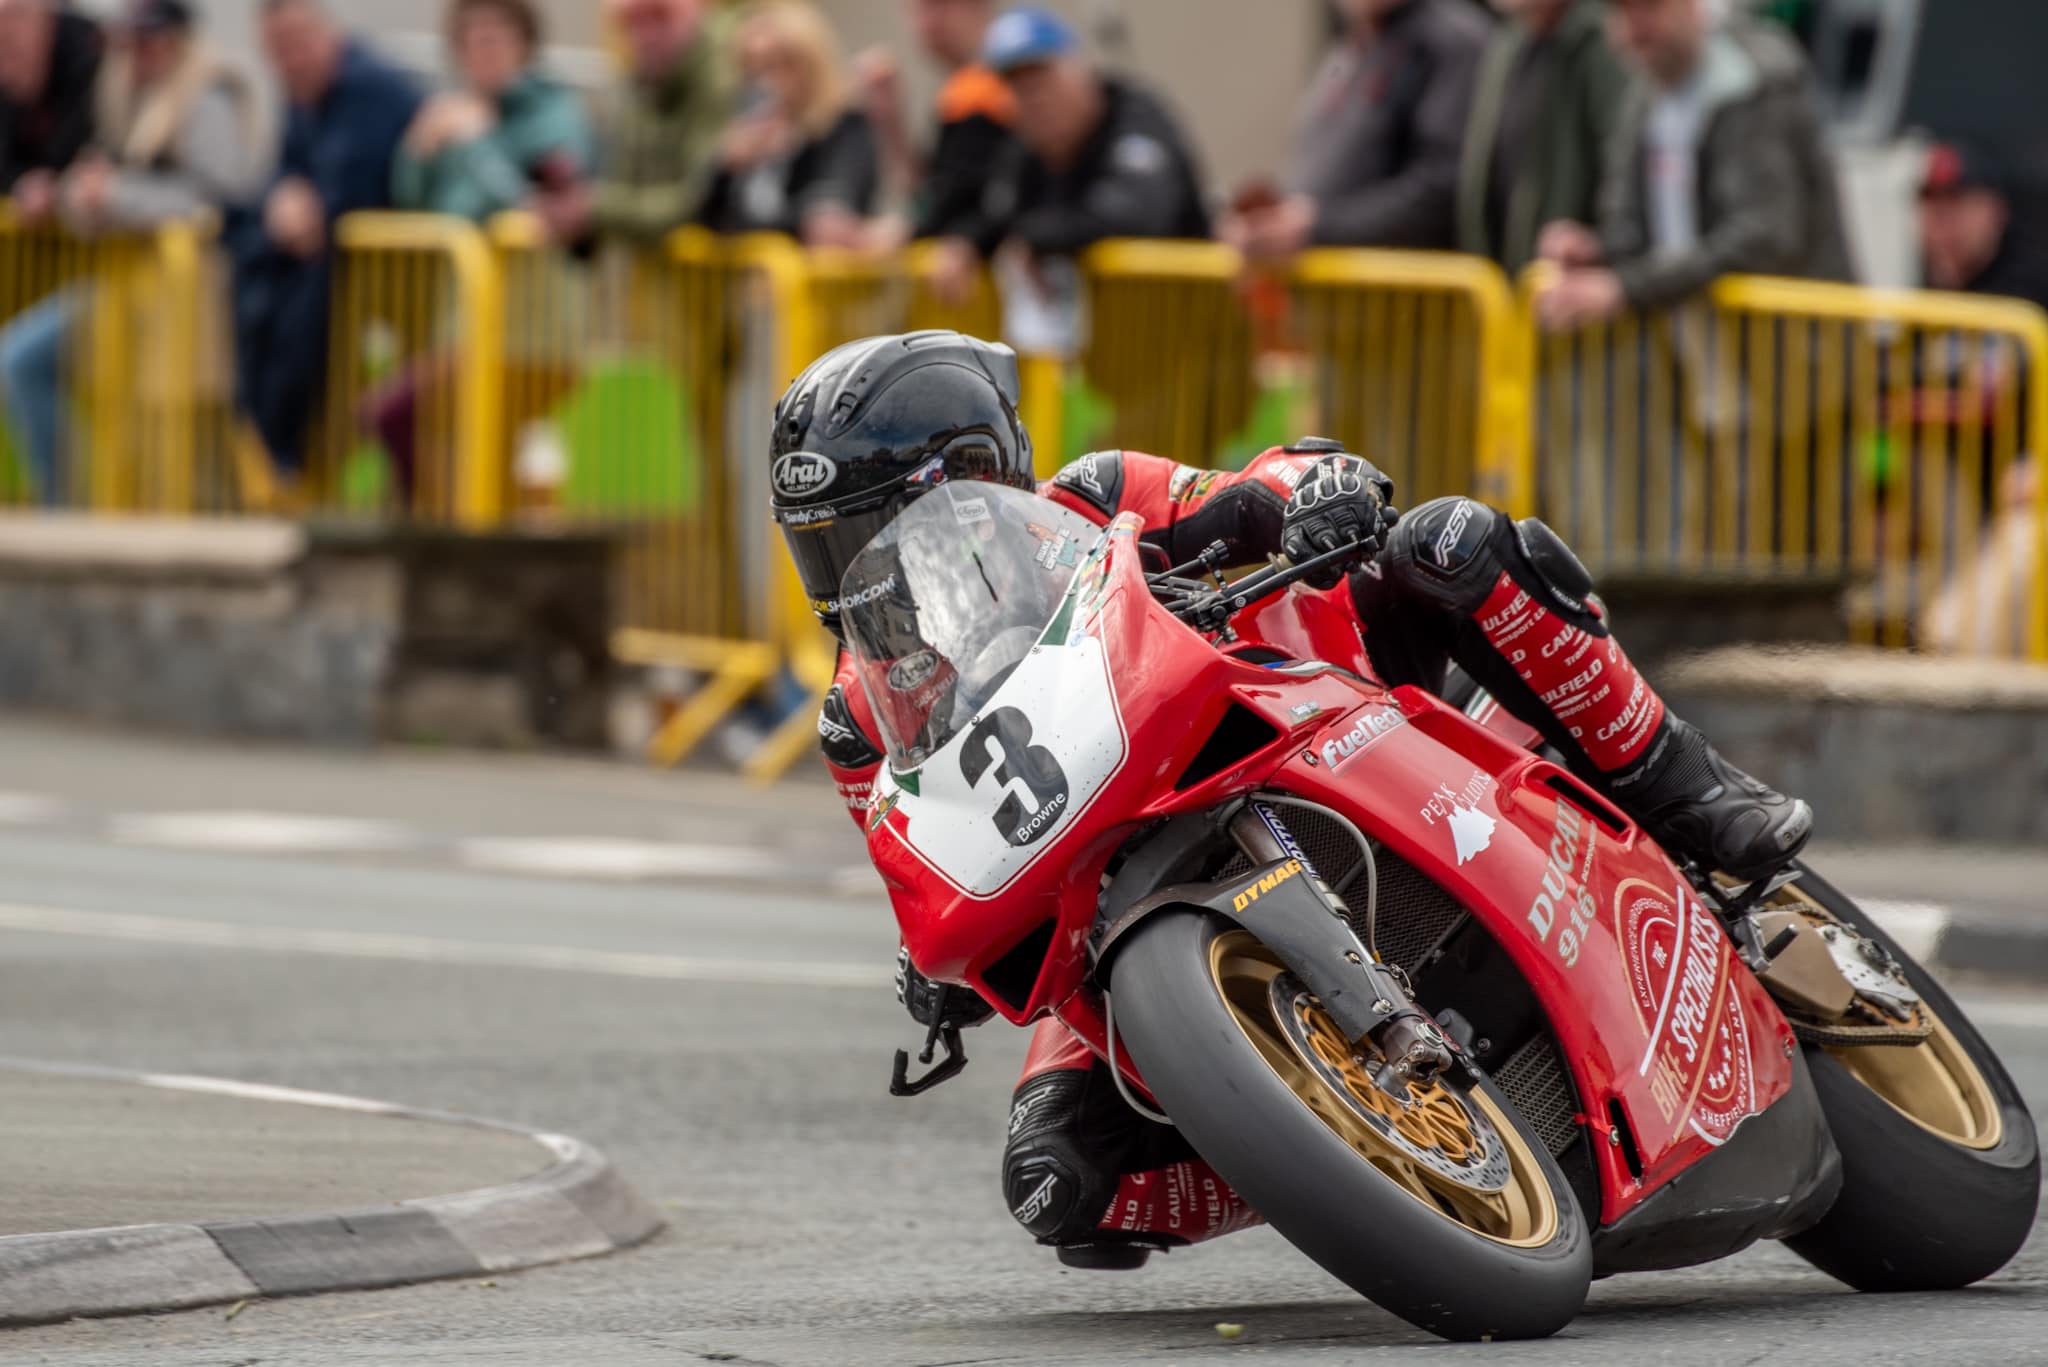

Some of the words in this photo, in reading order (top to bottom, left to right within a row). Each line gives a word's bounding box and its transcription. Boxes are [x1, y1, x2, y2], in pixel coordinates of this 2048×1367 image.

[778, 457, 826, 485] Arai
[1435, 499, 1473, 568] RST
[1321, 704, 1408, 769] FuelTech
[959, 705, 1070, 847] 3
[1420, 782, 1457, 824] PEAK
[1016, 791, 1067, 843] Browne
[1232, 858, 1302, 912] DYMAG
[1527, 795, 1583, 943] DUCATI
[1557, 884, 1597, 970] 916
[1671, 901, 1721, 1064] SPECIALISTS
